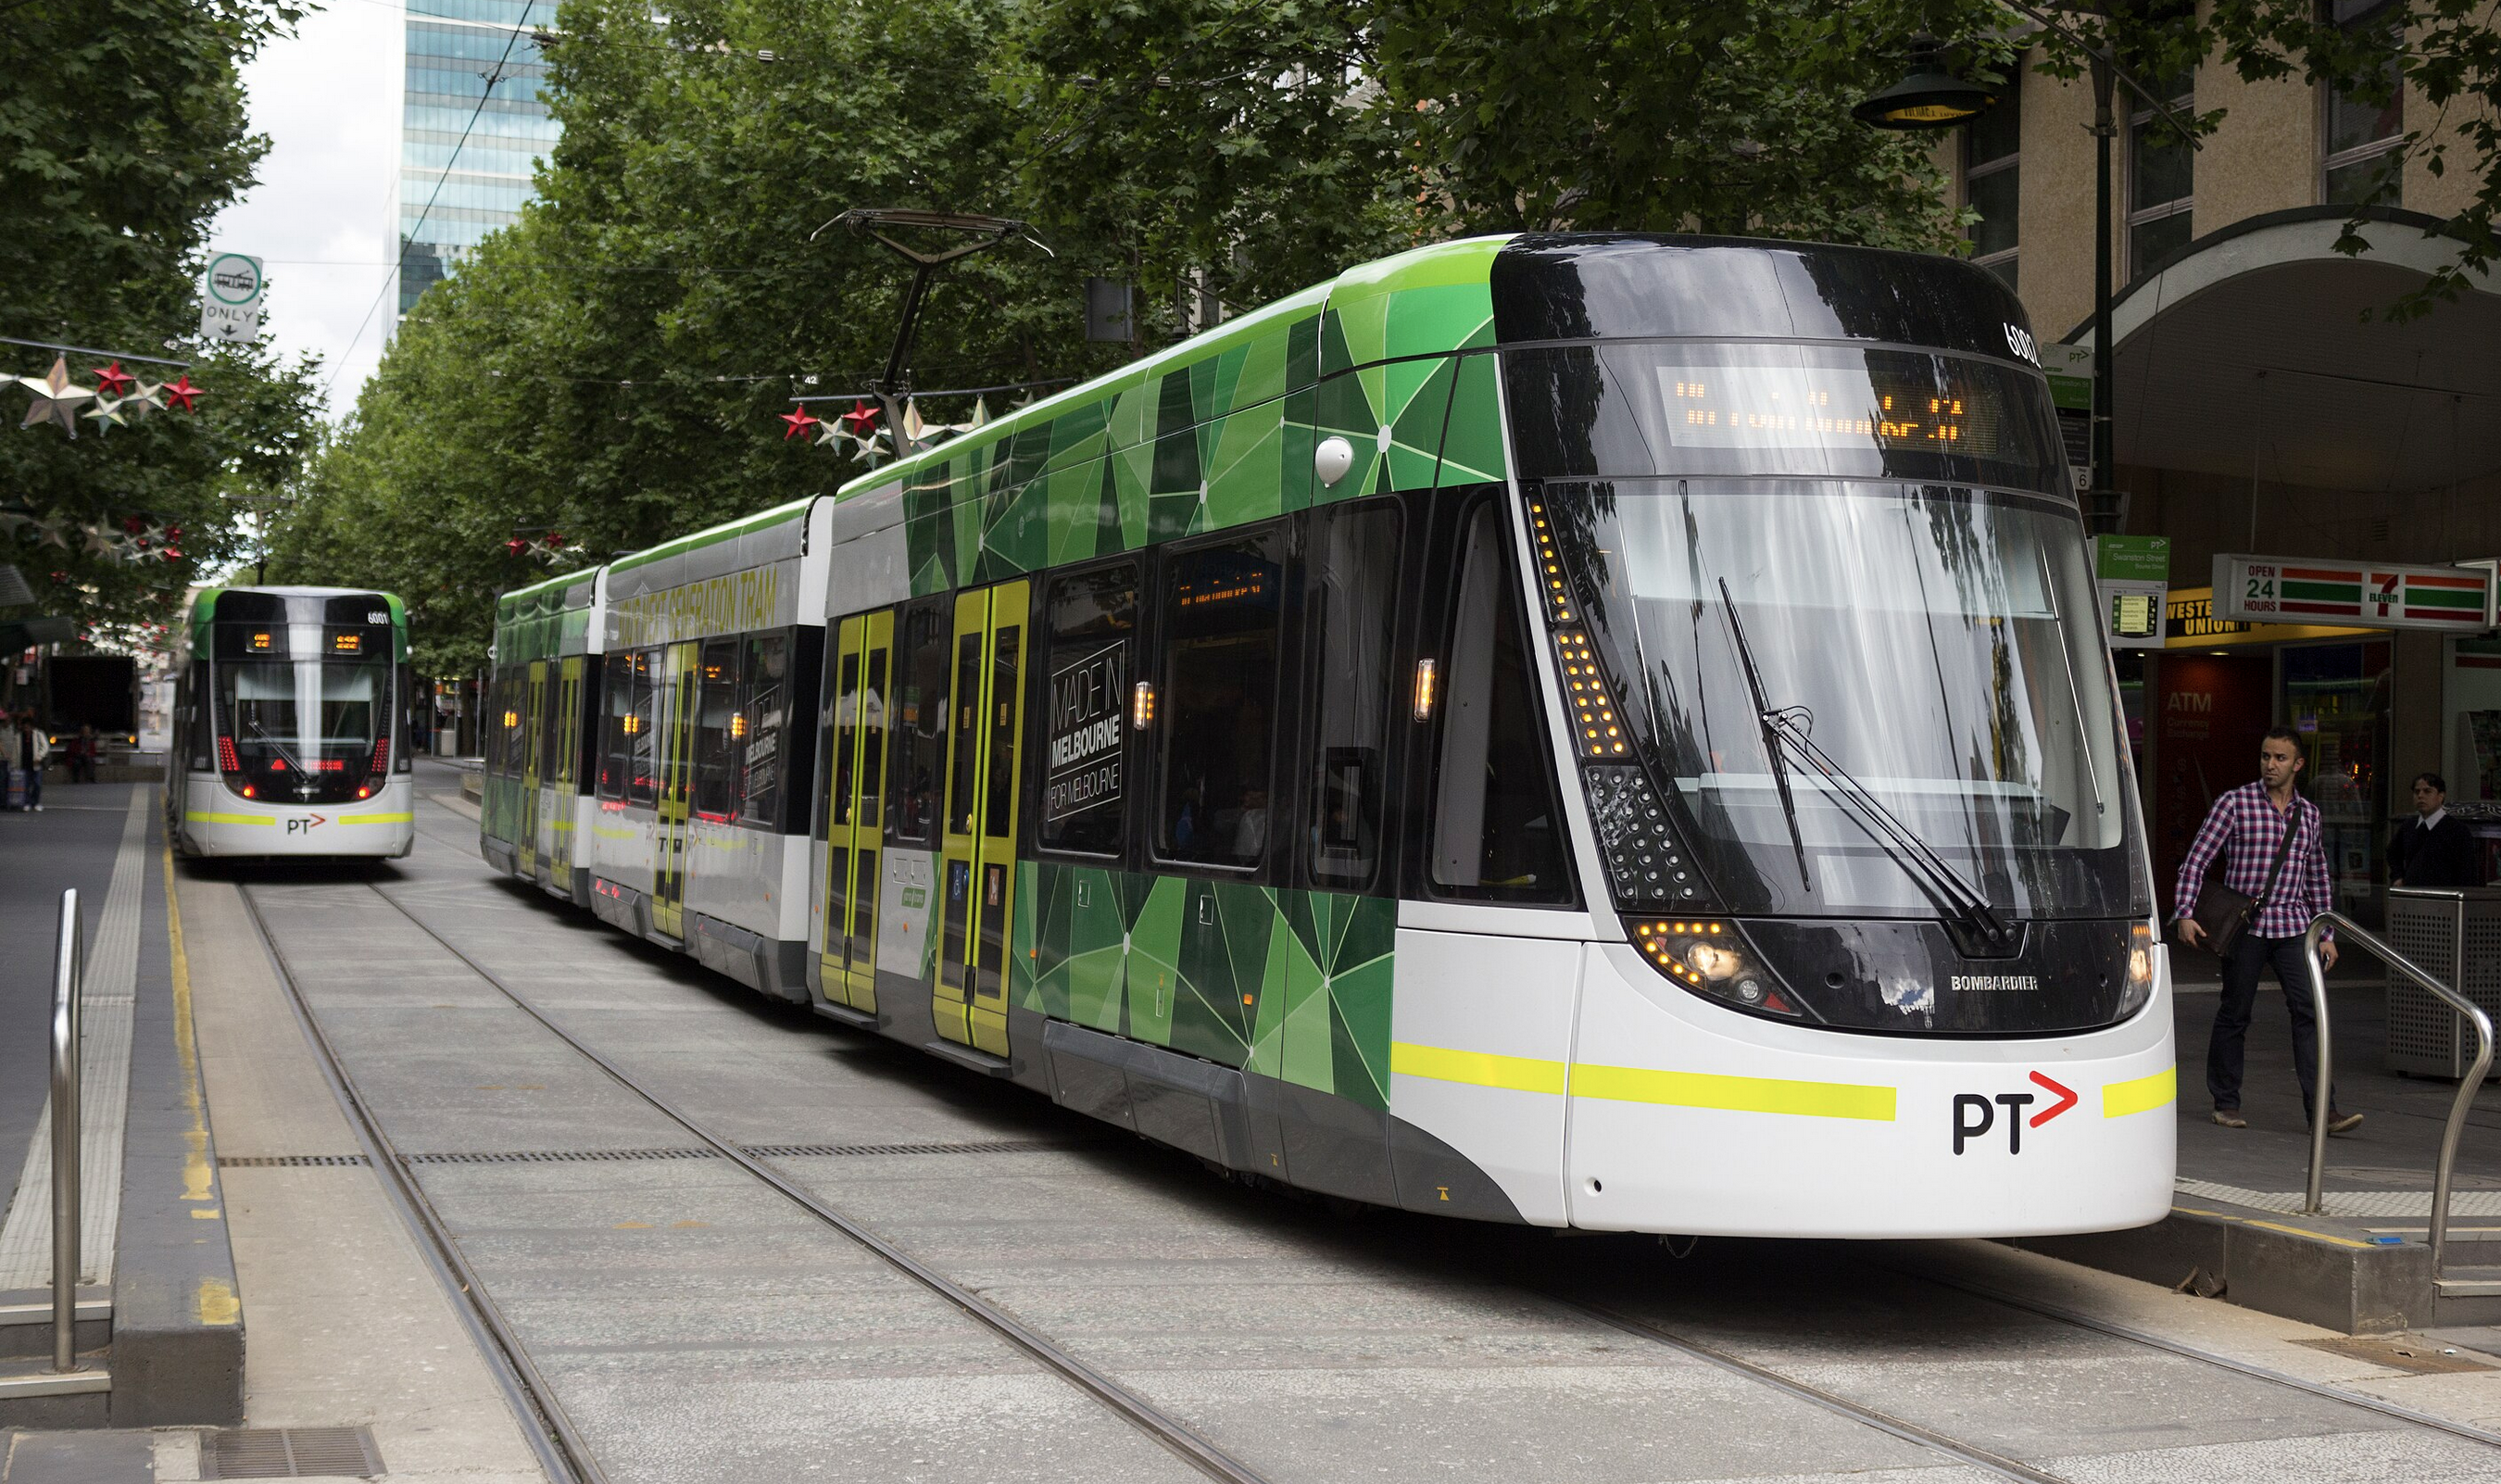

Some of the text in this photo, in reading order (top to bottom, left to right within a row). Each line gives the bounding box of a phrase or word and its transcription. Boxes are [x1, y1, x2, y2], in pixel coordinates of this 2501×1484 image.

[206, 306, 254, 322] ONLY
[2003, 321, 2042, 370] 6002
[804, 375, 818, 384] 42
[2079, 473, 2087, 487] 6
[2113, 552, 2166, 563] Swanston Street
[2248, 564, 2276, 579] OPEN
[2246, 579, 2275, 599] 24
[2370, 572, 2399, 618] 7
[669, 573, 738, 641] GENERATION
[740, 563, 777, 631] TRAM
[2166, 600, 2213, 620] WESTE
[2243, 599, 2277, 612] HOURS
[367, 611, 388, 625] 6001
[2184, 618, 2236, 635] UNION
[1051, 651, 1122, 734] MADE IN
[2167, 691, 2212, 712] ATM
[1051, 712, 1120, 769] MELBOURNE
[1050, 762, 1119, 811] FOR MELBOURNE
[1950, 975, 2039, 991] BOMBARDIER
